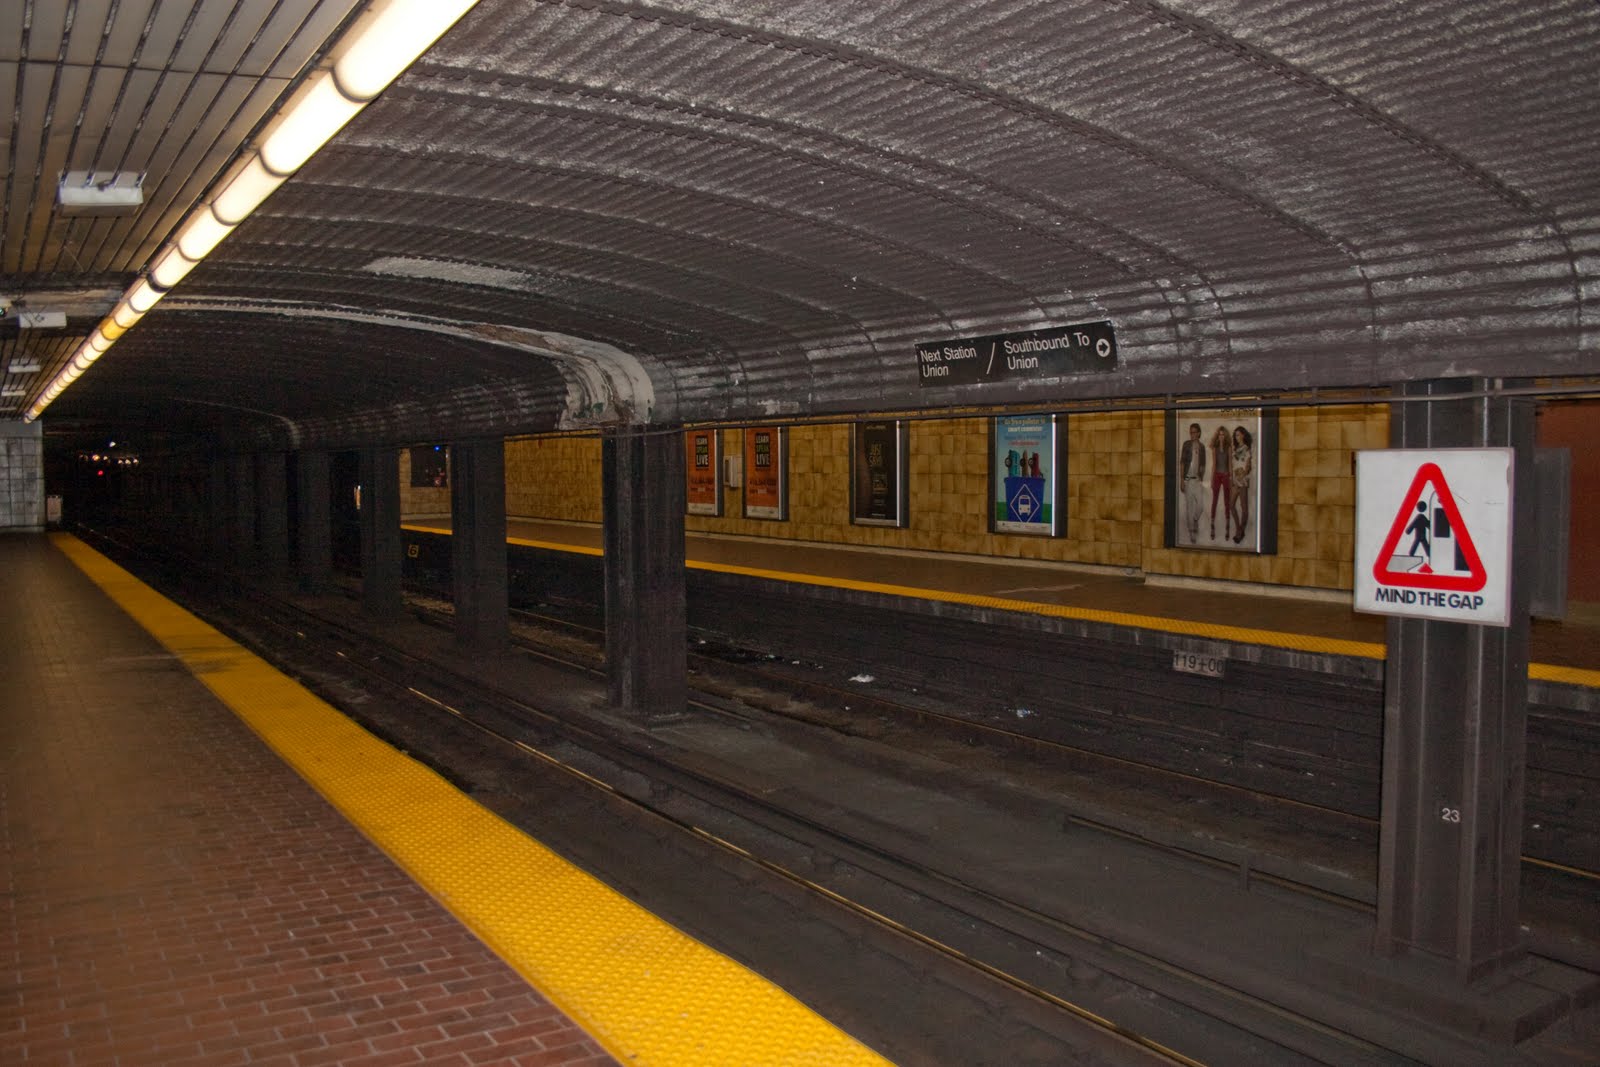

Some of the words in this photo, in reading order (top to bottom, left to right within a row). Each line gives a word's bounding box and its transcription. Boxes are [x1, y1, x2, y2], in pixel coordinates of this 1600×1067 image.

[1003, 333, 1070, 354] Southbound
[1073, 332, 1091, 347] To
[920, 348, 941, 363] Next
[943, 345, 977, 361] Station
[922, 363, 949, 378] Union
[1007, 356, 1039, 371] Union
[696, 454, 709, 465] LIVE
[756, 453, 770, 465] LIVE
[1375, 587, 1417, 604] MIND
[1418, 591, 1446, 608] THE
[1447, 593, 1484, 610] GAP
[1174, 653, 1224, 673] 119+00
[1441, 807, 1461, 823] 23
